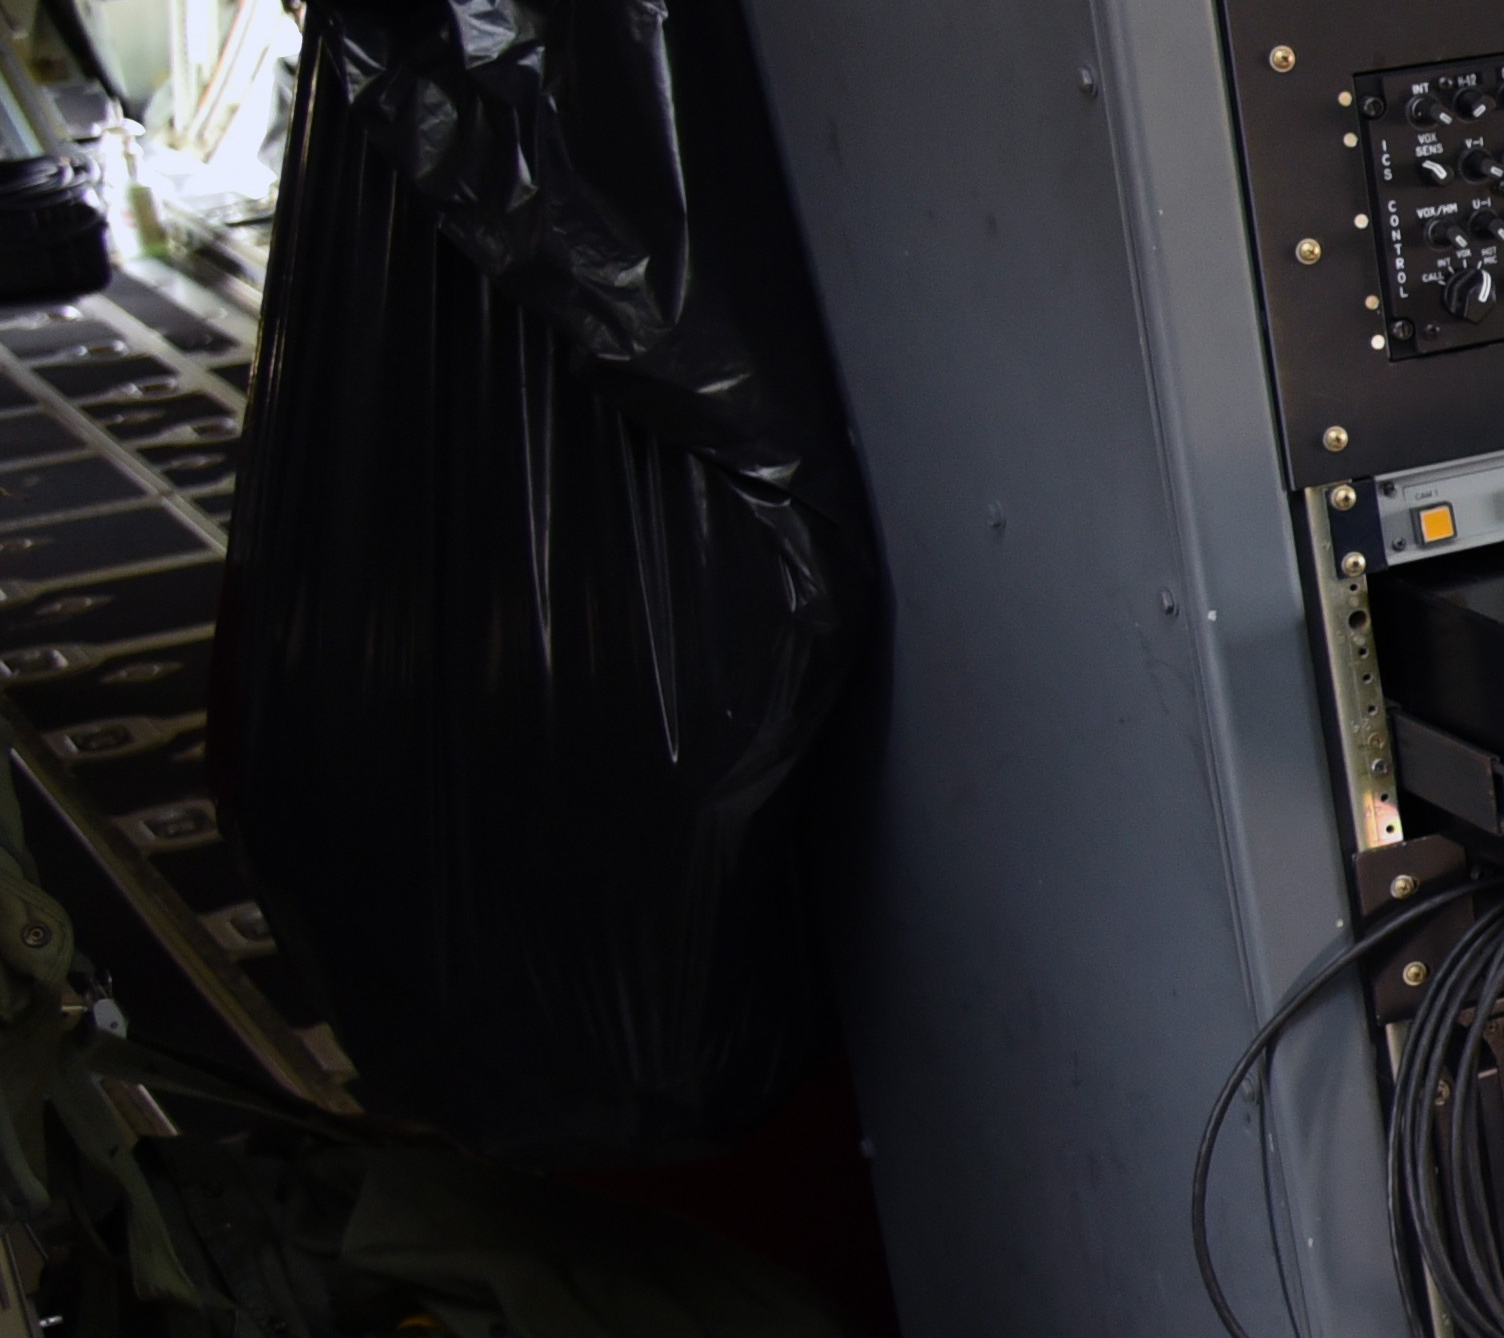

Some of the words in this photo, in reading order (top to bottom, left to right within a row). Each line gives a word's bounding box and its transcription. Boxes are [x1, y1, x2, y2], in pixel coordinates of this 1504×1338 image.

[1412, 82, 1430, 94] INT
[1417, 132, 1438, 144] VOX
[1415, 143, 1444, 157] SENS
[1422, 272, 1444, 283] CALL
[1415, 491, 1433, 500] CAM
